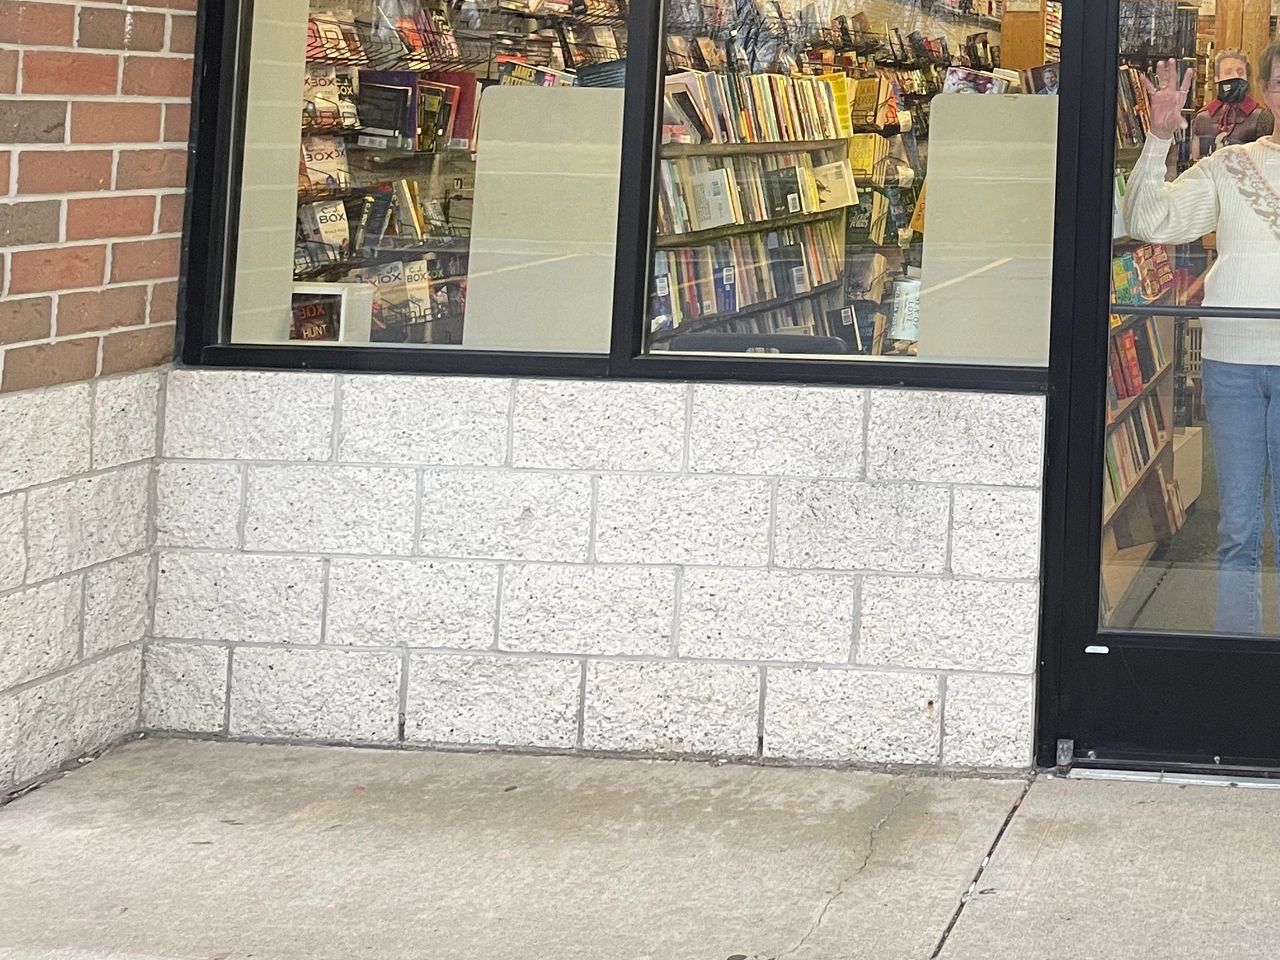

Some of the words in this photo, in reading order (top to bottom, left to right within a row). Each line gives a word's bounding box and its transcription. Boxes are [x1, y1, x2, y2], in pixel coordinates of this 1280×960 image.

[338, 86, 354, 96] OX
[319, 213, 346, 224] BOX
[407, 272, 427, 283] BOX
[303, 324, 327, 339] HUNT
